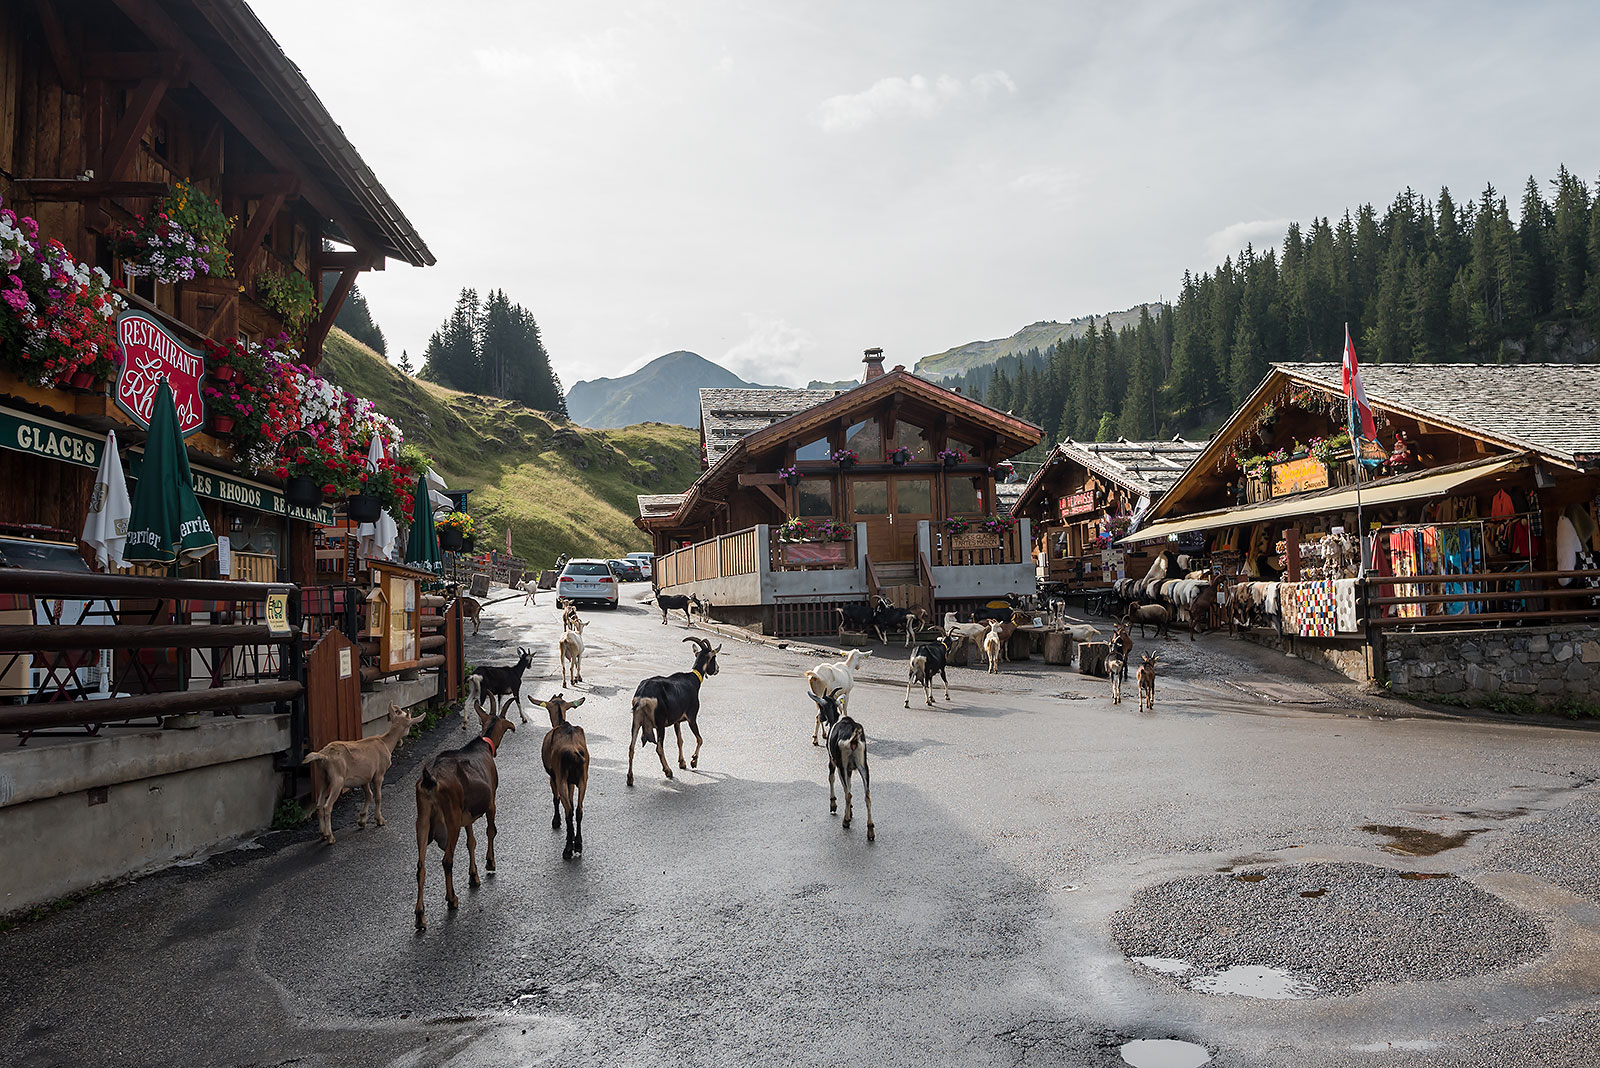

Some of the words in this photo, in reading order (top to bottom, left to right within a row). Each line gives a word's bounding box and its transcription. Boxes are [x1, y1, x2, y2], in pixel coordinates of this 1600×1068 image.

[124, 320, 198, 378] RESTAURANT
[121, 370, 199, 426] Rhos
[17, 424, 95, 464] GLACES
[190, 472, 212, 495] LES
[219, 480, 261, 507] RHODOS
[180, 516, 213, 542] errie
